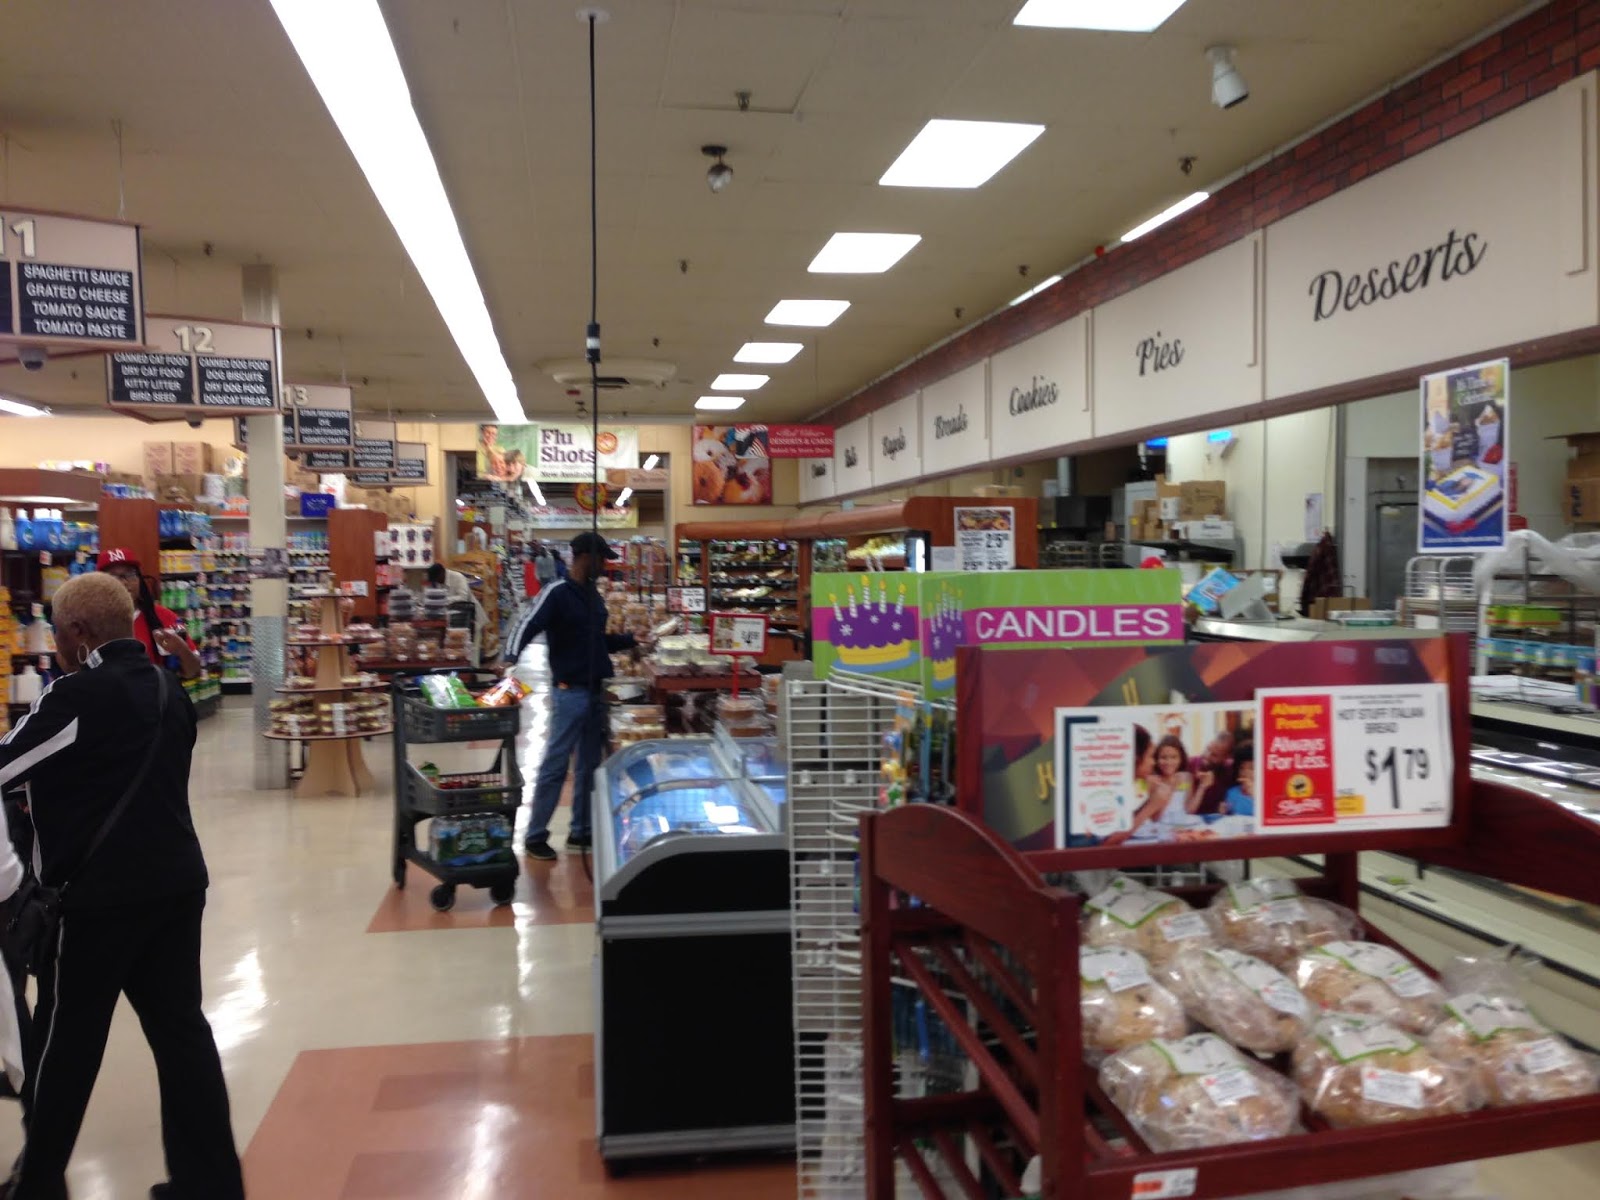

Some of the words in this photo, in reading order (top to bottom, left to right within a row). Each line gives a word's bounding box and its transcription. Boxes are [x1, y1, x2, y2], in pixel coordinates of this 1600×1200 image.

[24, 264, 89, 283] SPAGHETTI
[90, 269, 130, 287] SAUCE
[1308, 228, 1488, 322] Desserts
[26, 281, 77, 300] GRATED
[79, 286, 129, 304] CHEESE
[31, 300, 83, 318] TOMATO
[85, 304, 127, 321] SAUCE
[34, 318, 85, 336] TOMATO
[87, 322, 127, 339] PASTE
[174, 325, 215, 353] 12
[149, 354, 165, 365] CAT
[166, 355, 189, 367] FOOD
[1136, 330, 1185, 377] Pies
[121, 365, 140, 376] DRY
[140, 365, 158, 377] CAT
[159, 366, 185, 379] FOOD
[231, 359, 248, 369] DOG
[248, 360, 269, 371] FOOD
[124, 378, 150, 389] KITTY
[150, 380, 181, 391] LITTER
[206, 368, 226, 380] DOG
[226, 370, 264, 382] BISCUITS
[129, 389, 152, 401] BIRD
[152, 391, 177, 403] SEED
[204, 381, 222, 392] DRY
[223, 382, 243, 393] DOG
[243, 383, 267, 395] FOOD
[284, 386, 309, 406] 13
[1009, 375, 1060, 416] Cookies
[240, 395, 273, 407] TREATS
[933, 403, 968, 439] Breads
[541, 429, 573, 446] Flu
[541, 446, 596, 464] Shots
[975, 607, 1171, 640] CANDLES
[1271, 702, 1324, 721] Always
[1270, 736, 1326, 756] Always
[1267, 753, 1292, 770] For
